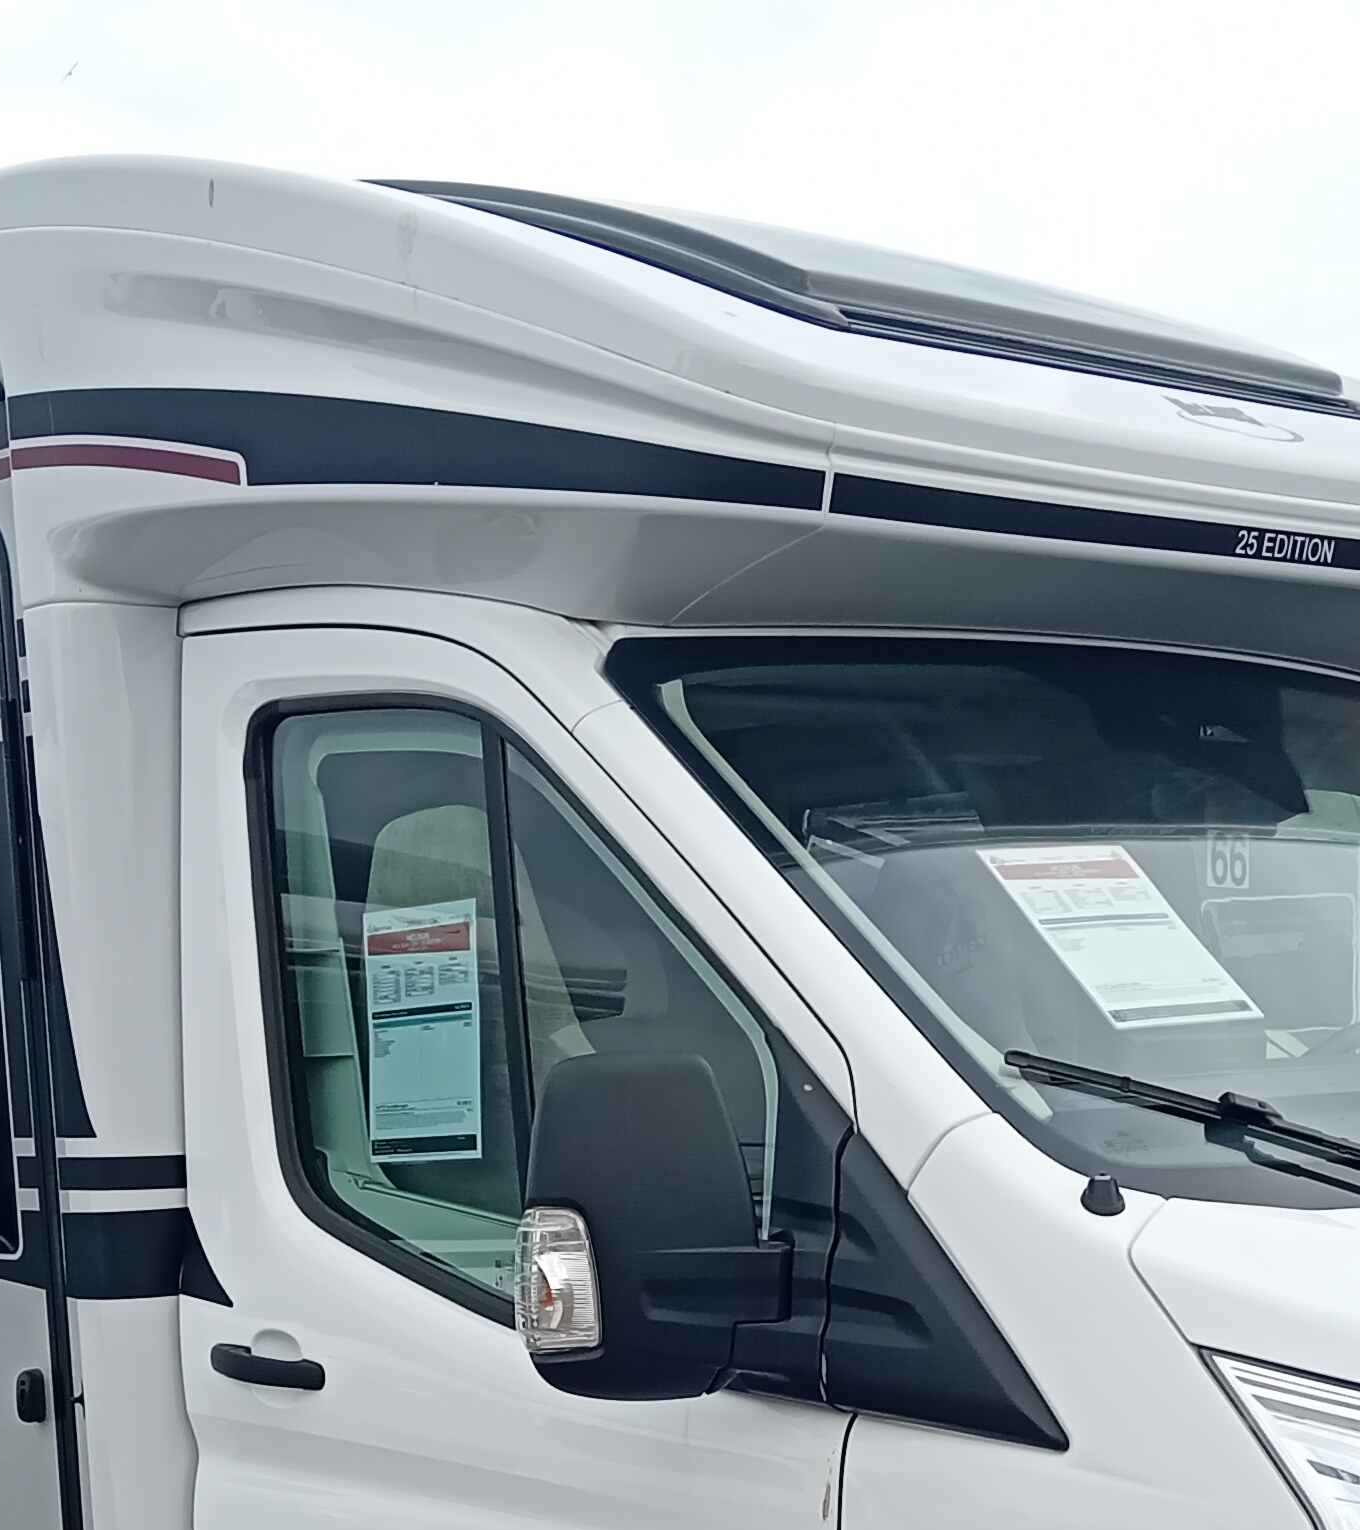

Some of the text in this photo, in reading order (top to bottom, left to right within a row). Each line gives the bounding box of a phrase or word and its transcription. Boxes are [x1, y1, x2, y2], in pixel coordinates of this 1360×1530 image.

[1234, 529, 1336, 564] 25 EDITION
[1210, 831, 1248, 887] 66
